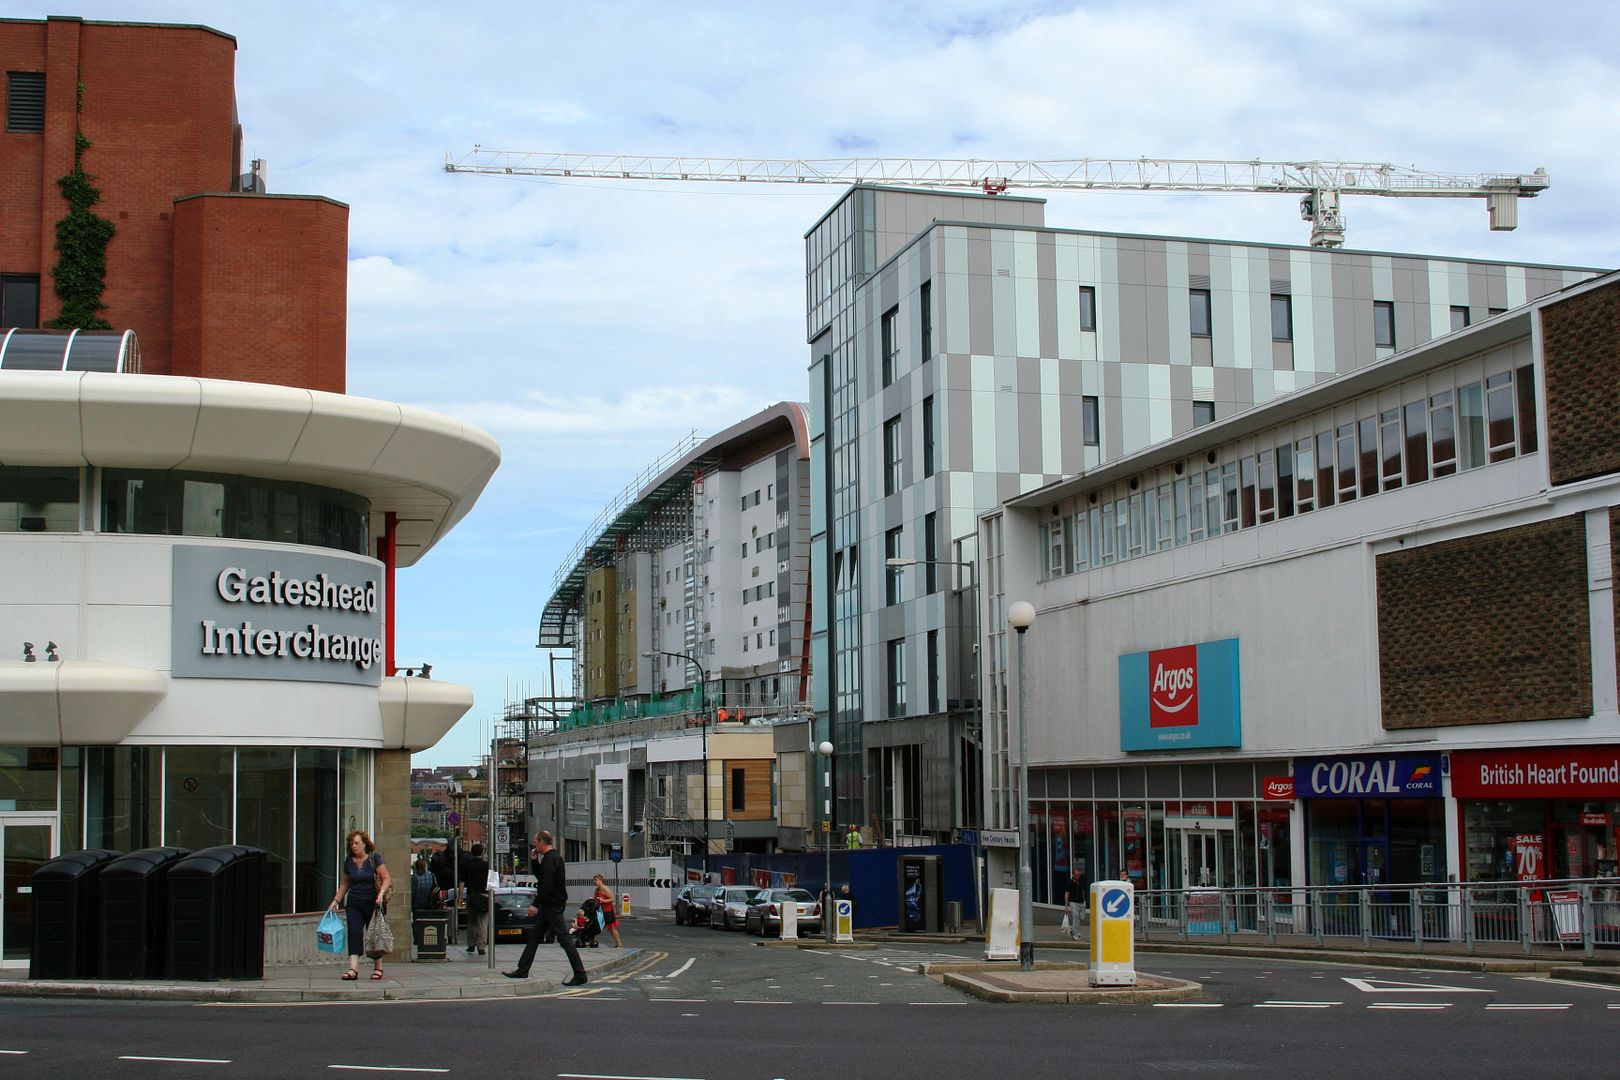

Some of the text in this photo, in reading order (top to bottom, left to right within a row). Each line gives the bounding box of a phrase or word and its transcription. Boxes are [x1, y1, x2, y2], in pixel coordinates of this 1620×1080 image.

[218, 567, 377, 613] Gateshead
[201, 619, 382, 669] Interchange
[1153, 663, 1193, 700] Argos
[1268, 781, 1293, 793] Argos
[1311, 760, 1400, 794] CORAL
[1480, 760, 1620, 785] British Heart Found
[1516, 835, 1543, 844] SALE
[1516, 845, 1543, 875] 70%
[1522, 874, 1538, 882] OFF
